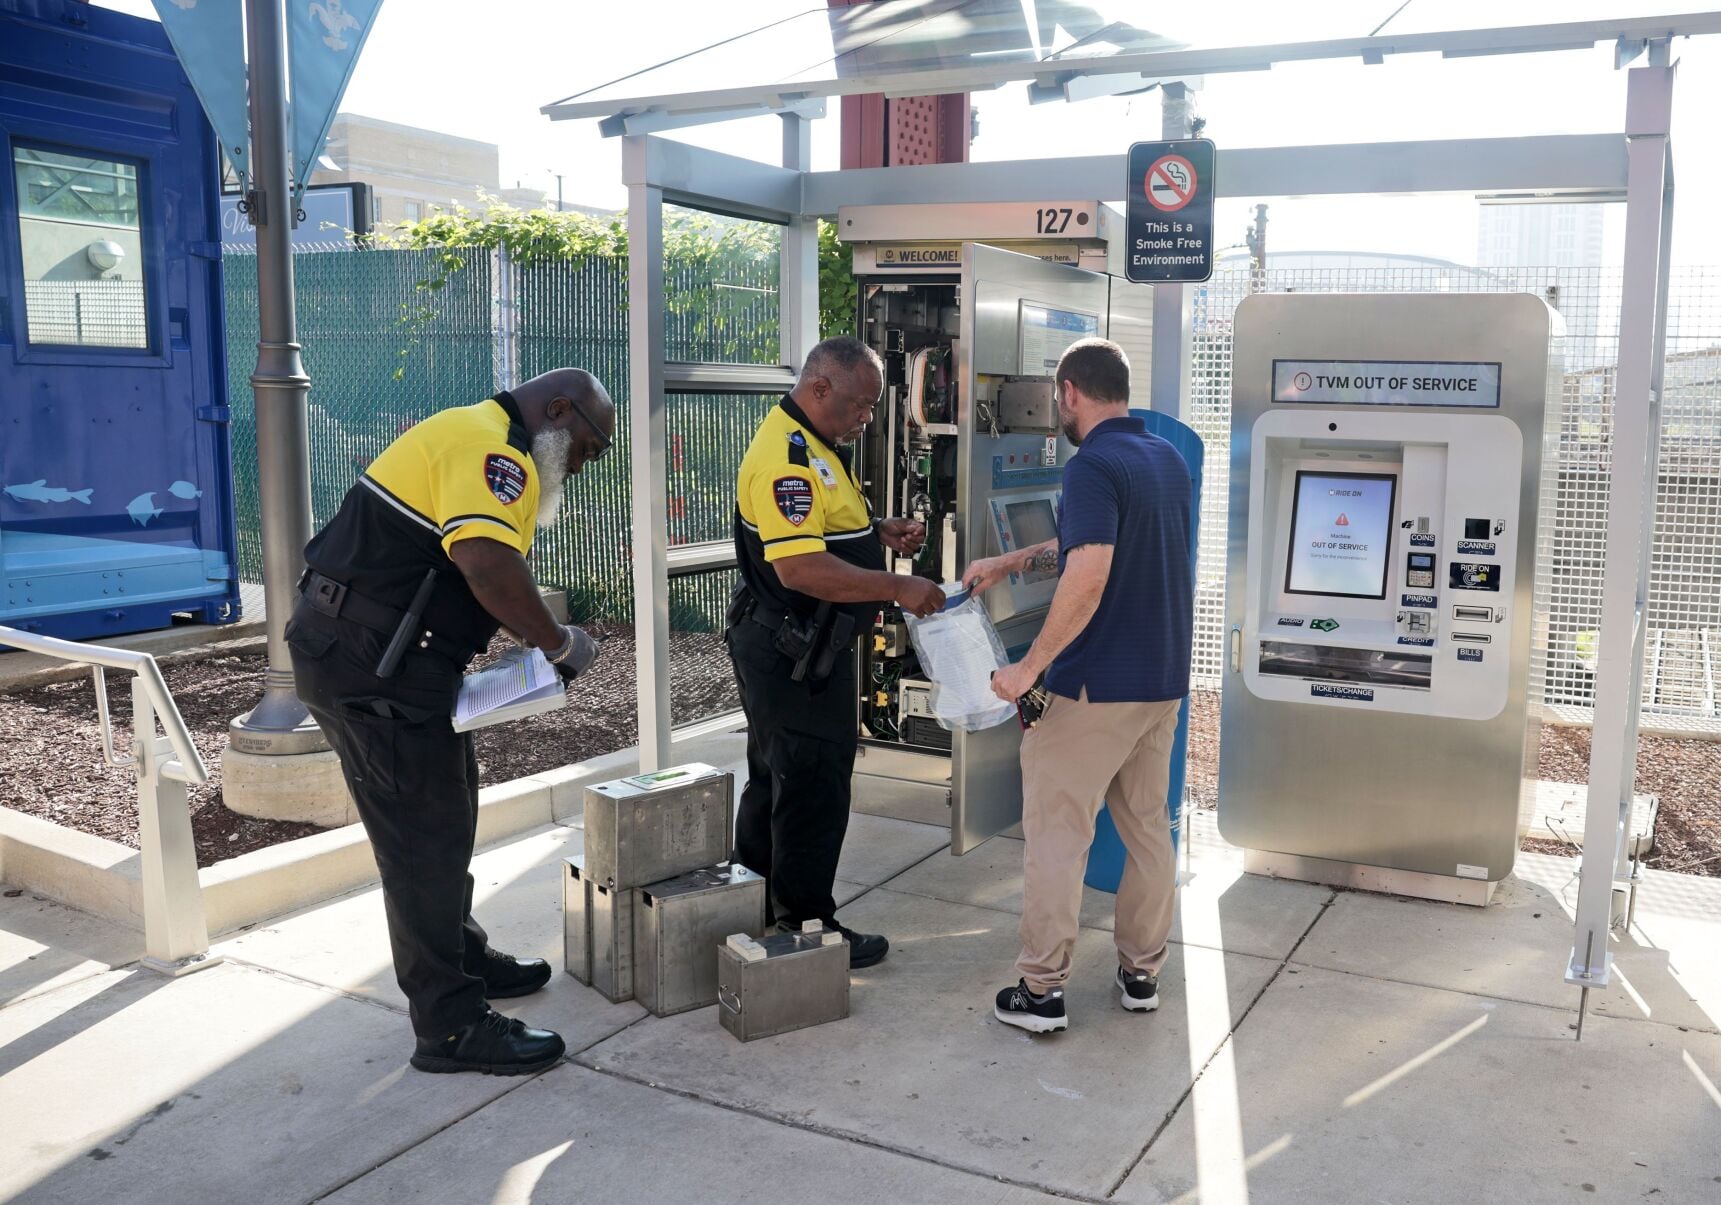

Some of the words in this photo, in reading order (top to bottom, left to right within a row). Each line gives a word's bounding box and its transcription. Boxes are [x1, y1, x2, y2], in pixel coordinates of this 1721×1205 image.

[1036, 208, 1072, 234] 127
[1146, 222, 1169, 232] This
[1173, 222, 1182, 232] is
[1186, 224, 1192, 232] a
[1136, 238, 1173, 249] Smoke
[1178, 238, 1202, 248] Free
[900, 251, 958, 262] WELCOME!
[1133, 254, 1204, 265] Environment
[1316, 376, 1349, 388] TVM
[1354, 376, 1384, 389] OUT
[1388, 377, 1408, 390] OF
[1412, 378, 1477, 391] SERVICE
[498, 458, 520, 472] metro
[1338, 543, 1368, 551] SERVICE
[1458, 541, 1495, 550] SCANNER
[1460, 648, 1480, 656] BILLS
[1312, 684, 1373, 696] TICKETS/CHANGE
